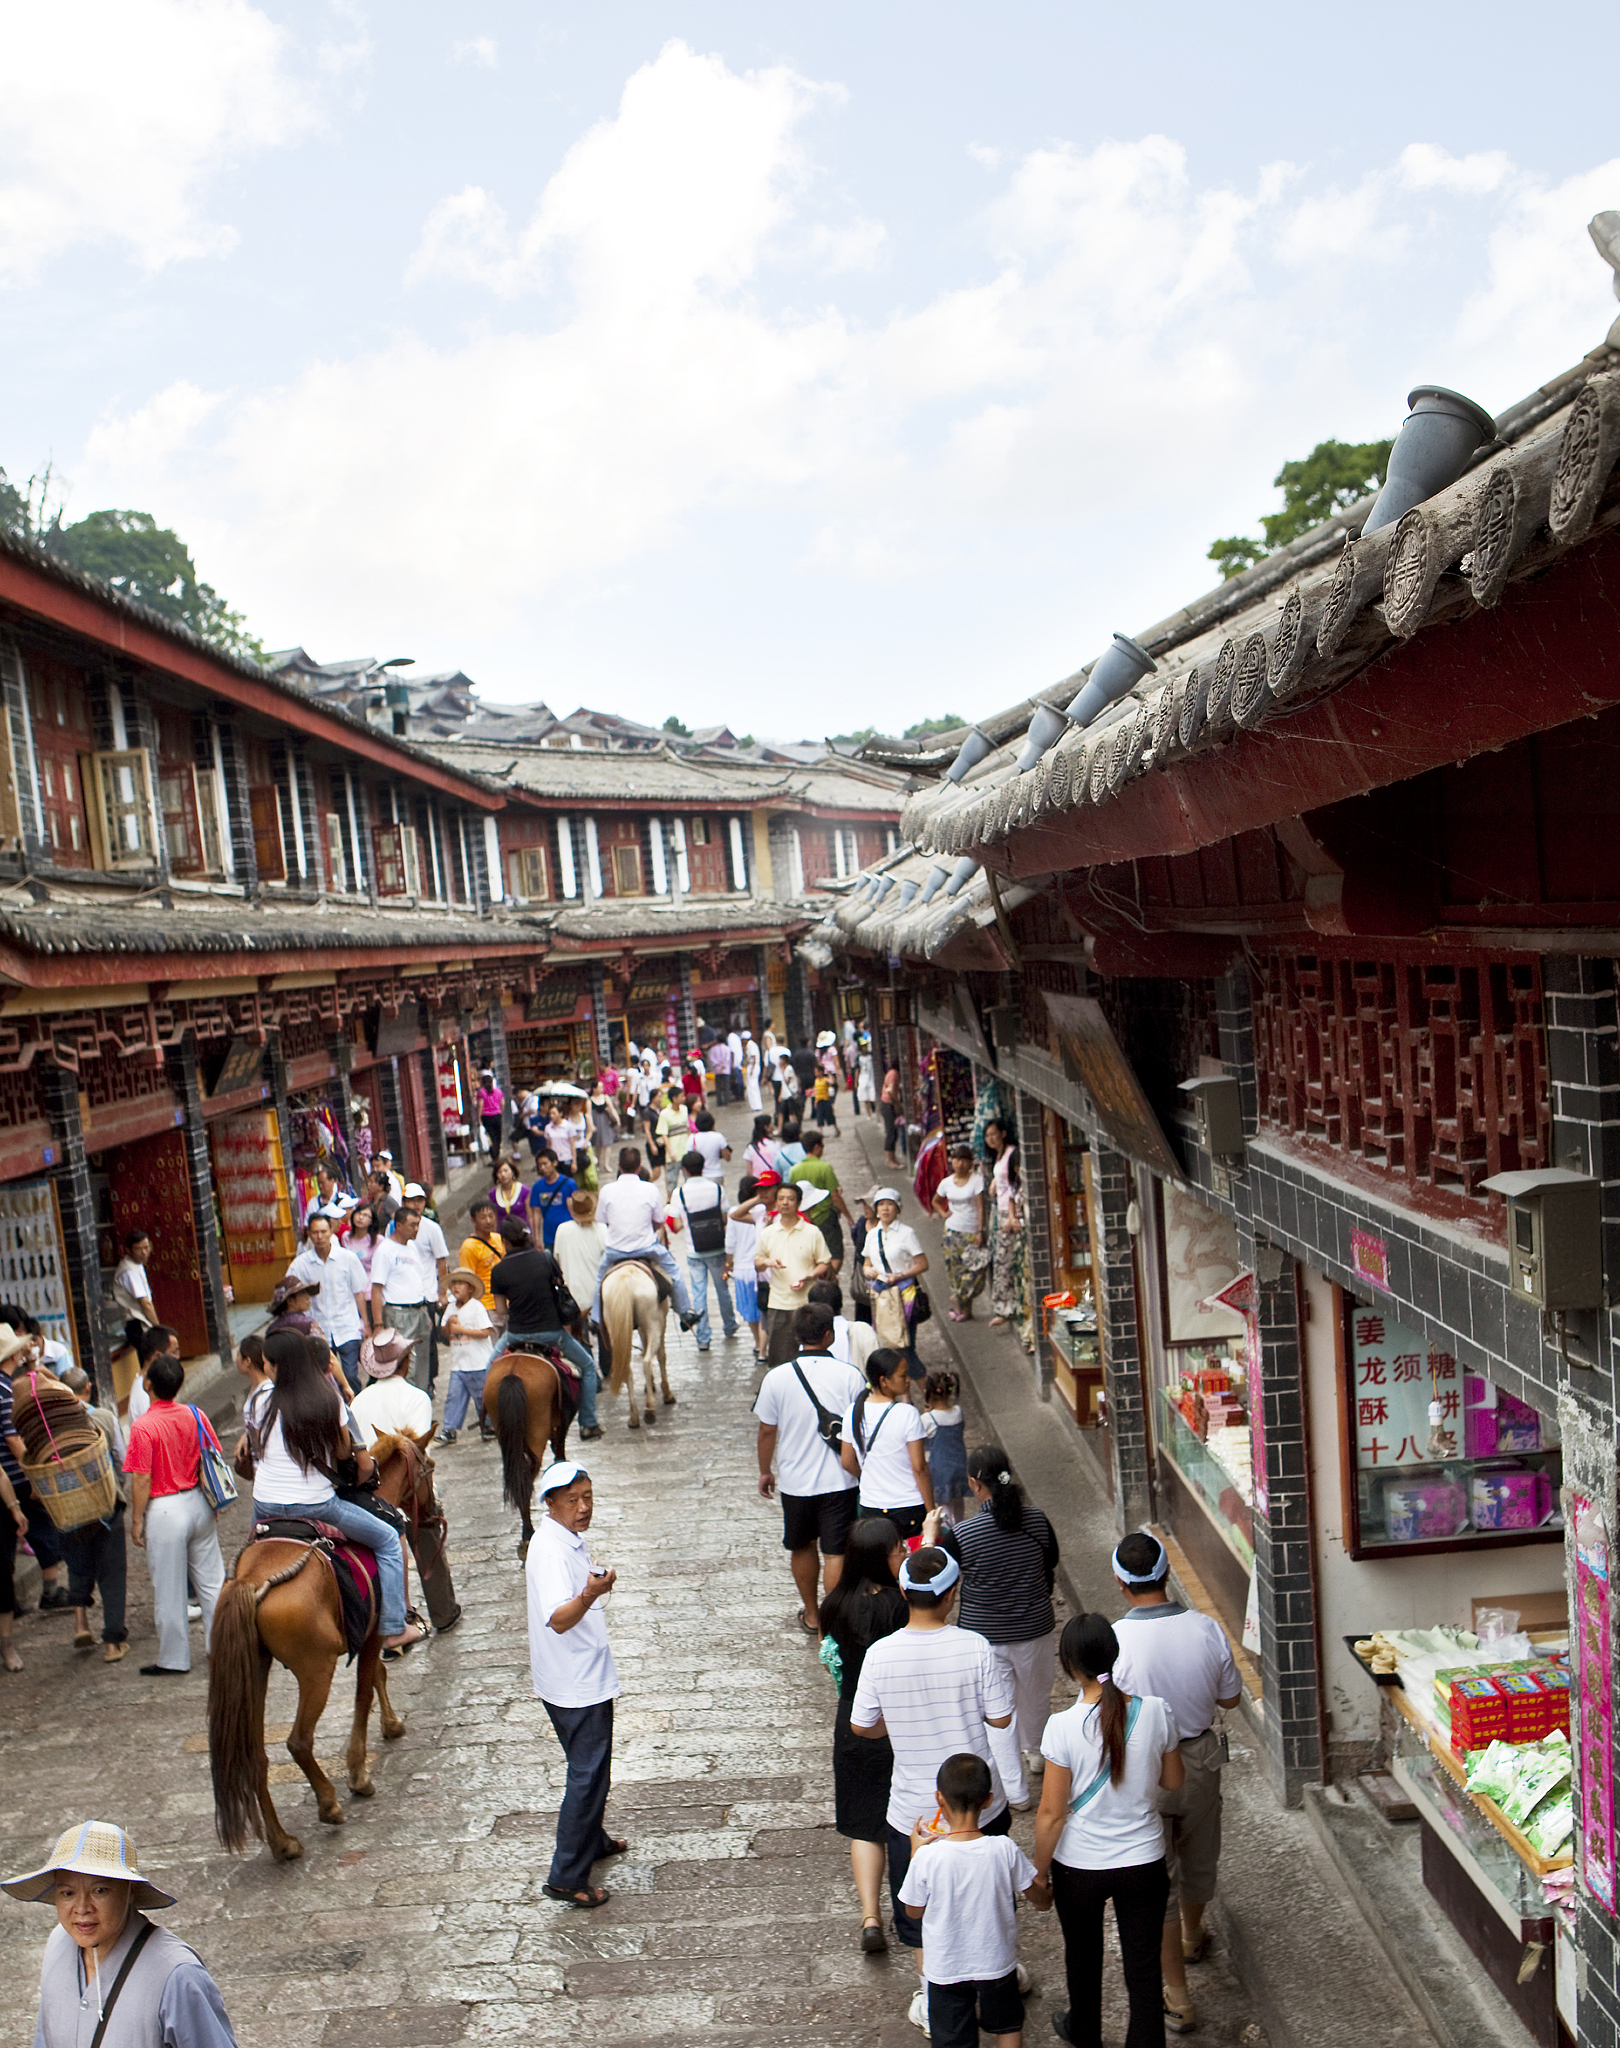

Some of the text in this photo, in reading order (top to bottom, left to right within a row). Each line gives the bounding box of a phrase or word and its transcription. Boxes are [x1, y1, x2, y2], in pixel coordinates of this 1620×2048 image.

[1356, 1315, 1386, 1347] 姜
[1358, 1352, 1457, 1387] 龙须糖
